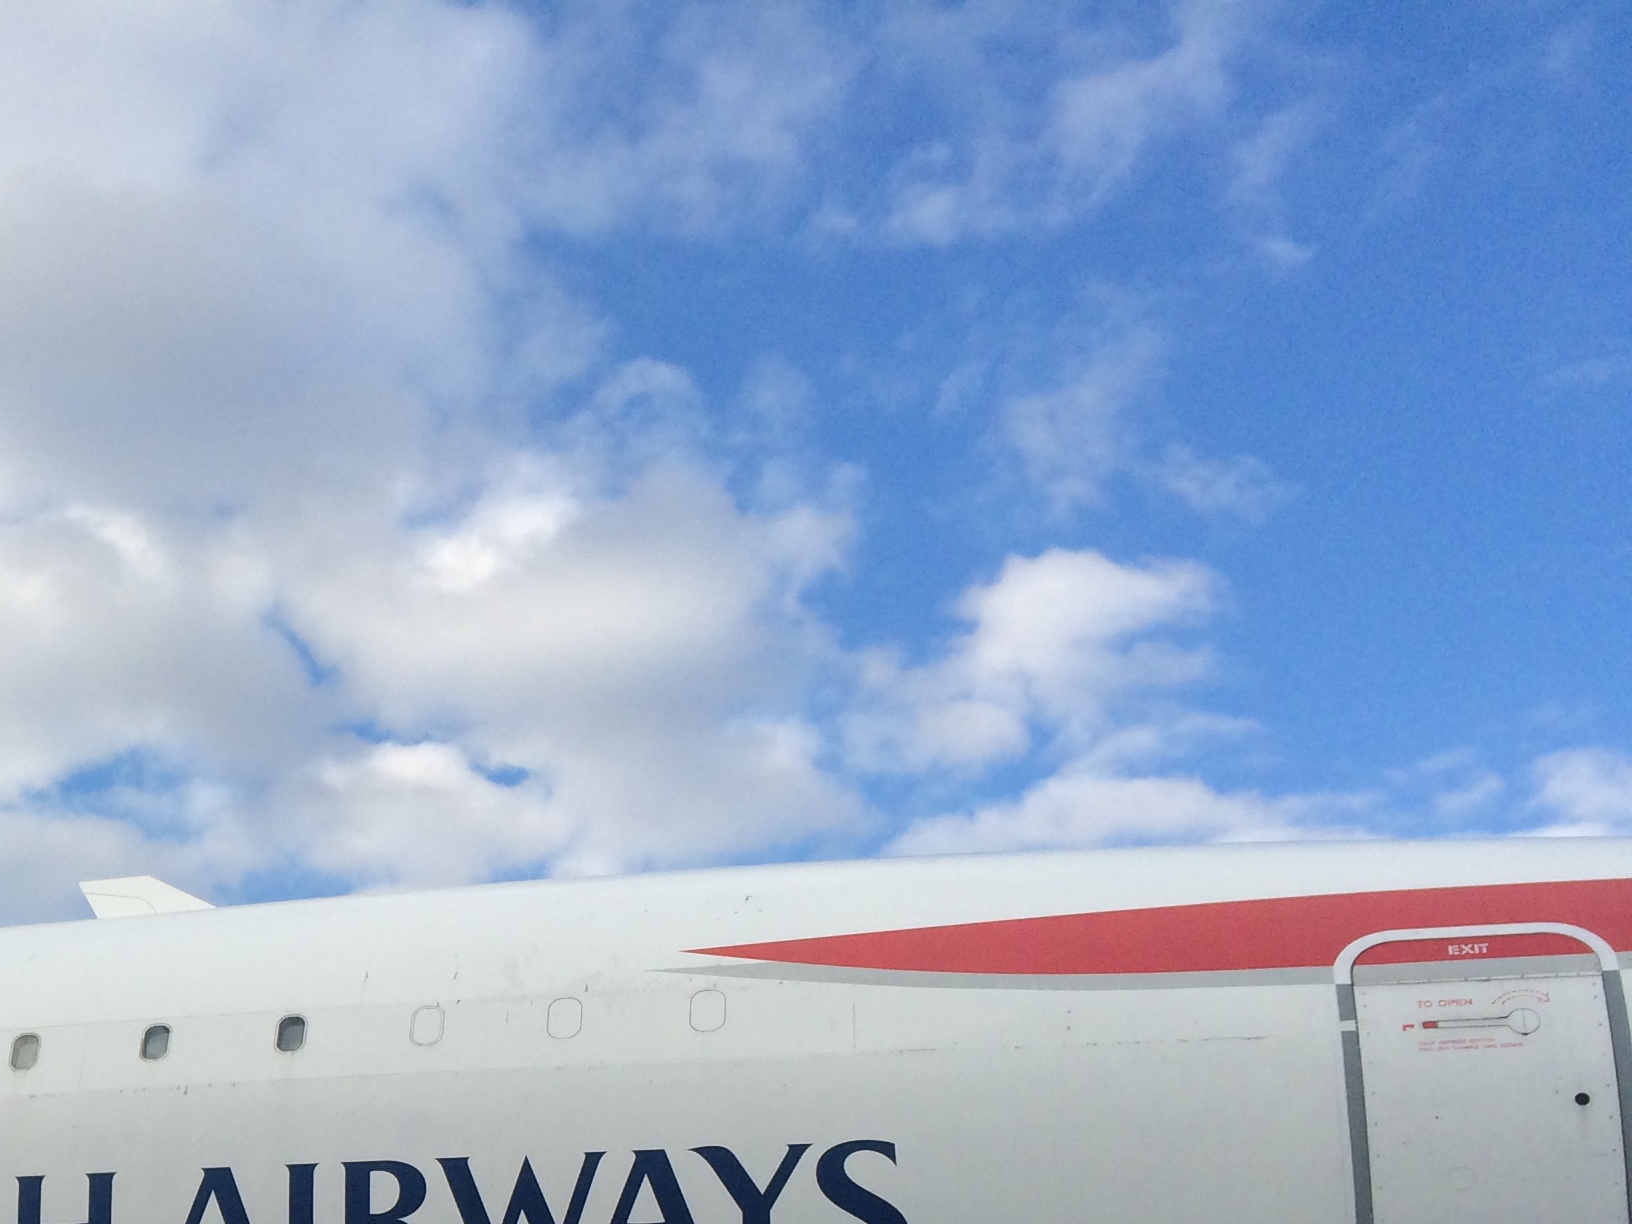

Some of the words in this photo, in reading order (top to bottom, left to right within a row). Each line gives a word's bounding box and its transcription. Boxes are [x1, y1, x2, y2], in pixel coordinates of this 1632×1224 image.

[1448, 943, 1488, 955] EXIT
[1417, 1000, 1432, 1008] TO
[1438, 998, 1473, 1007] OPEN
